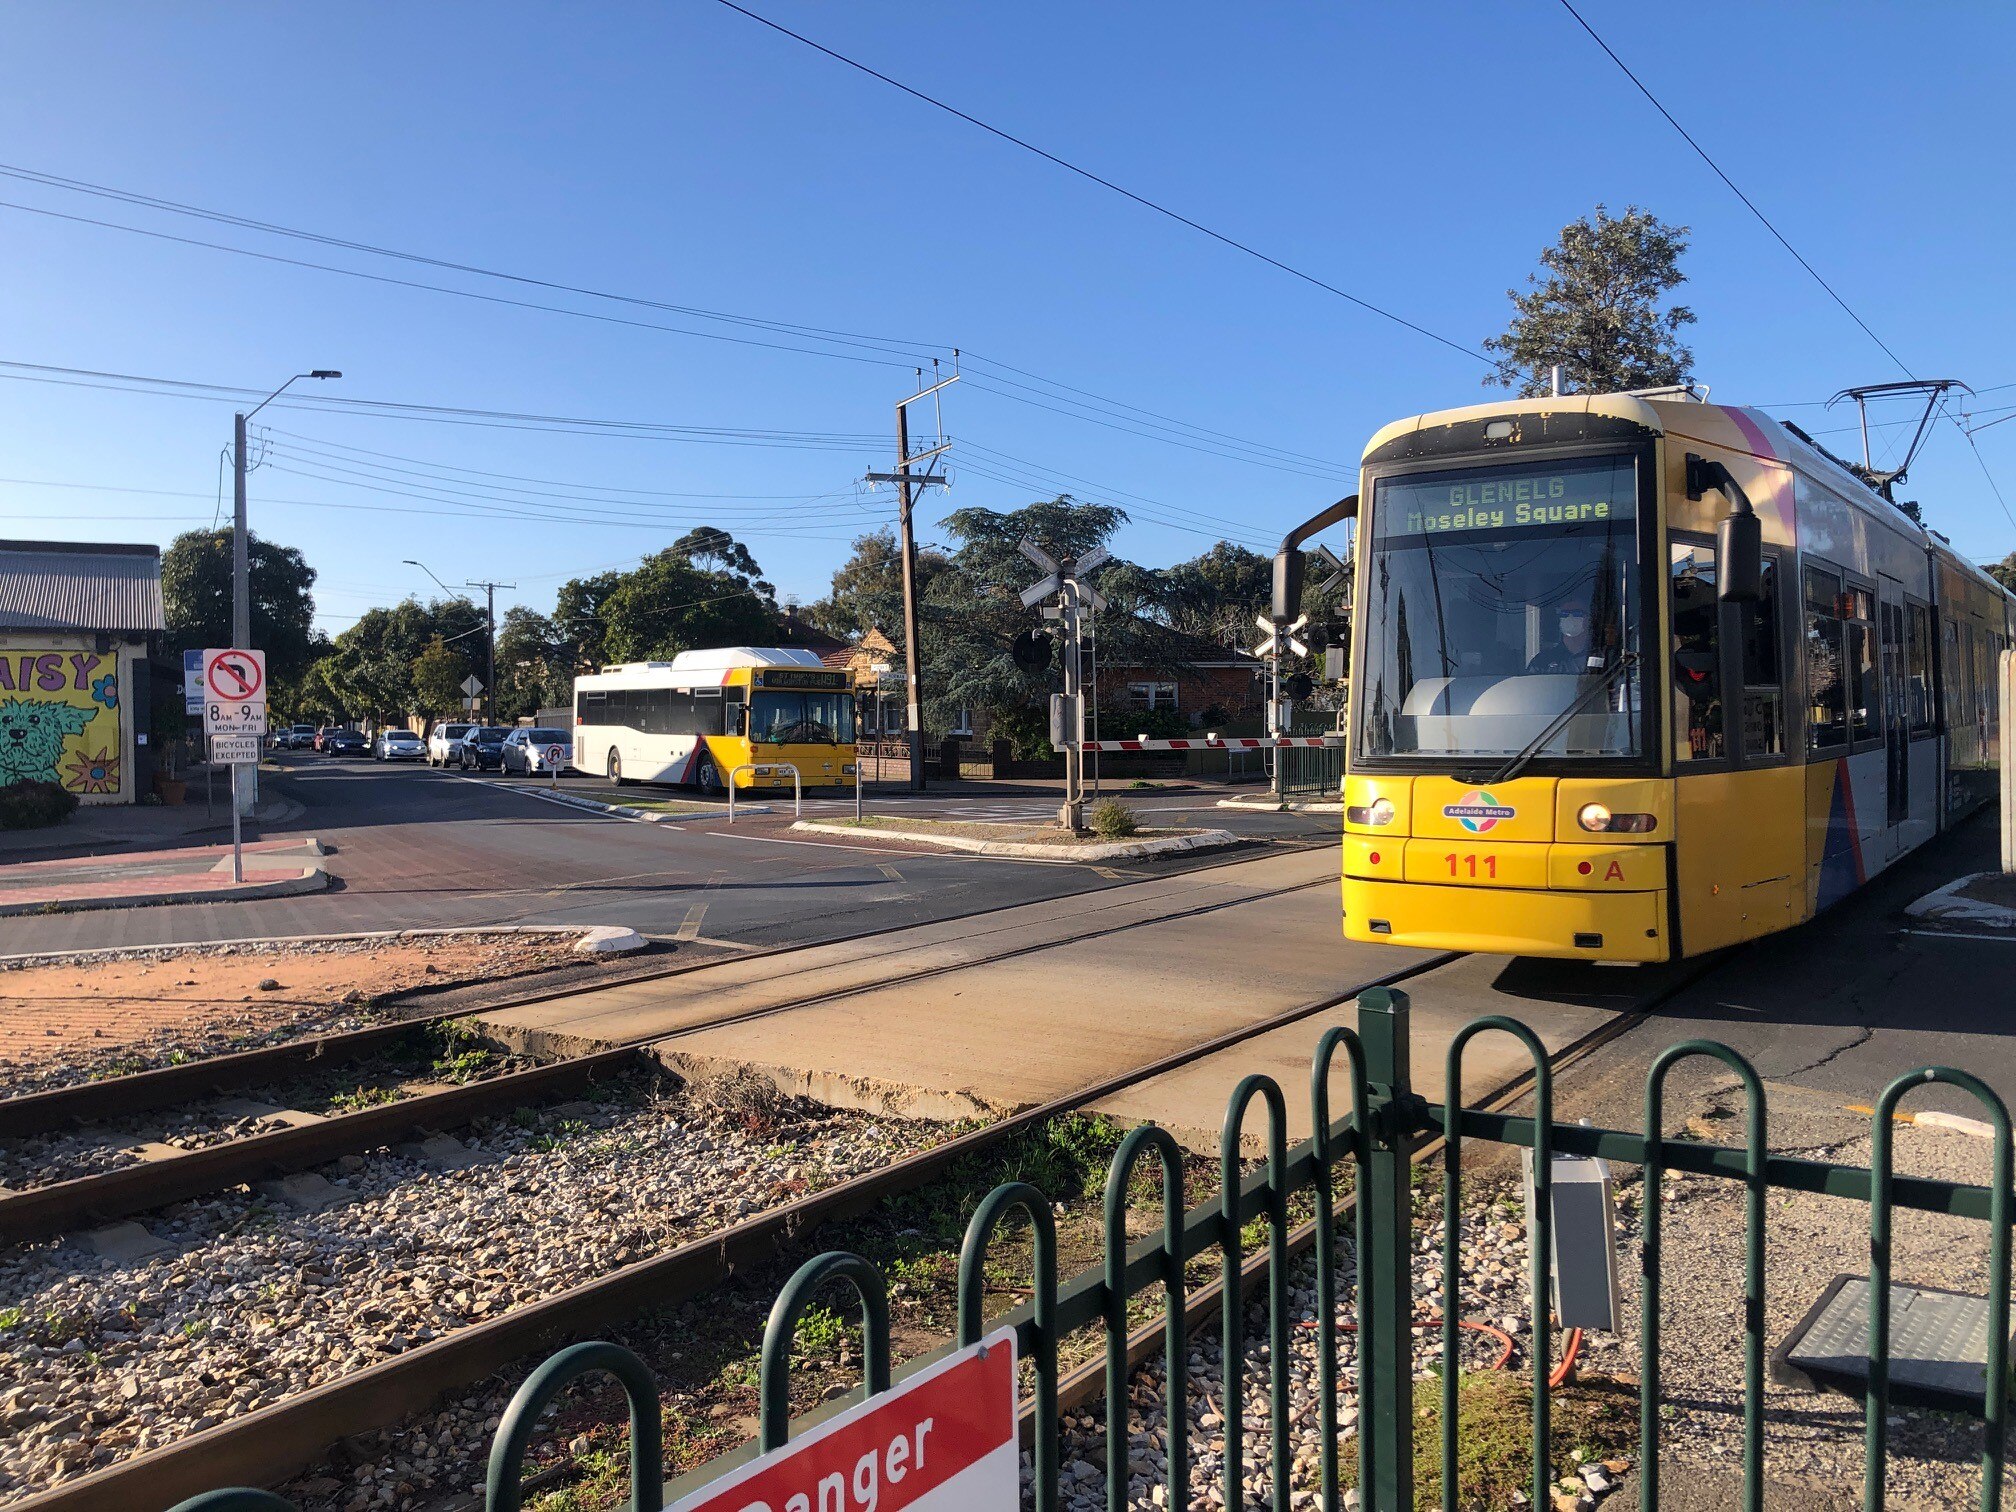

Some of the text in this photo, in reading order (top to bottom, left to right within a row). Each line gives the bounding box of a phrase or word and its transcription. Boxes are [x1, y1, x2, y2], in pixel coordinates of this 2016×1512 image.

[1450, 478, 1564, 507] GLENELG
[1407, 502, 1609, 532] Moseley Square
[215, 751, 256, 760] EXCEPTED
[216, 740, 255, 749] BICYCLES
[1448, 807, 1511, 816] Adelaide Metro
[1445, 854, 1496, 878] 111
[1604, 860, 1625, 881] A
[738, 1417, 934, 1512] nger
